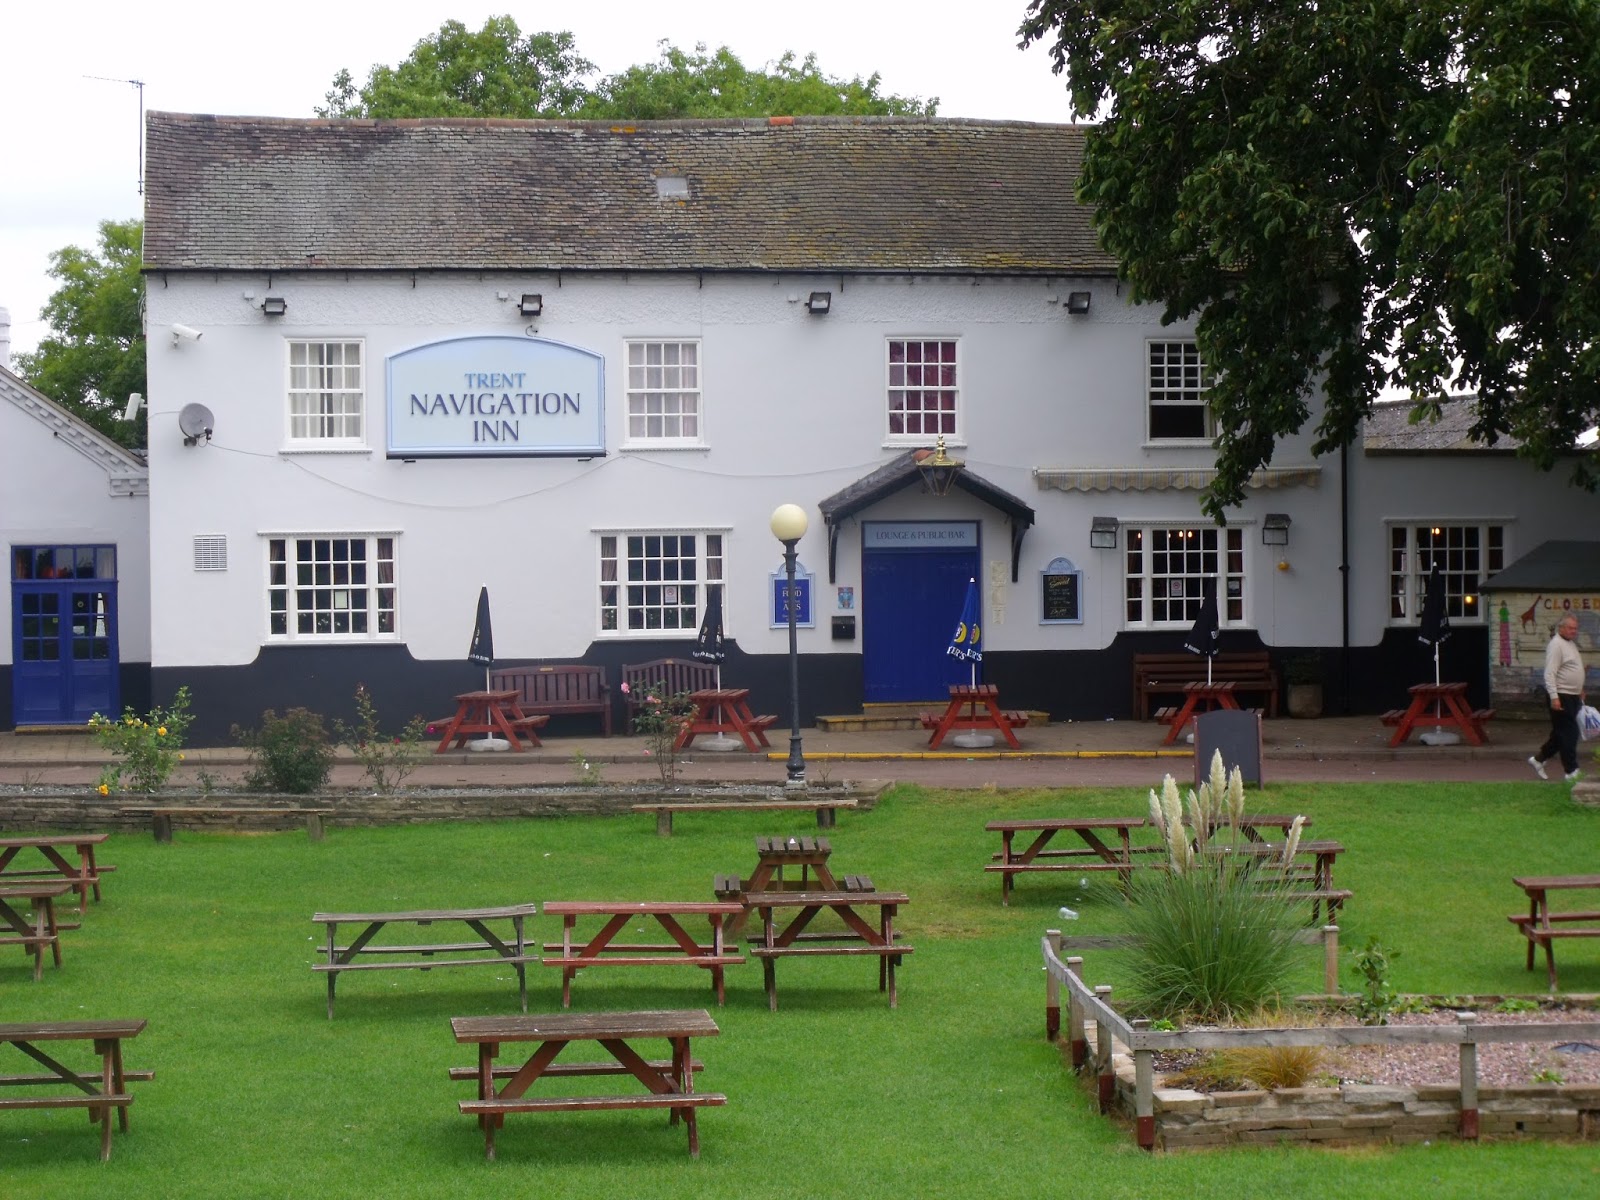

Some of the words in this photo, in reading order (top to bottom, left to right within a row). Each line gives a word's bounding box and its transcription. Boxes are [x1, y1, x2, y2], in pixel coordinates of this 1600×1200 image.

[464, 372, 526, 388] TRENT
[410, 392, 580, 415] NAVIGATION
[473, 420, 519, 442] INN
[876, 531, 909, 540] LOUNGE
[917, 531, 947, 539] PUBLIC
[948, 531, 965, 539] BAR
[1544, 598, 1600, 611] CLOSED
